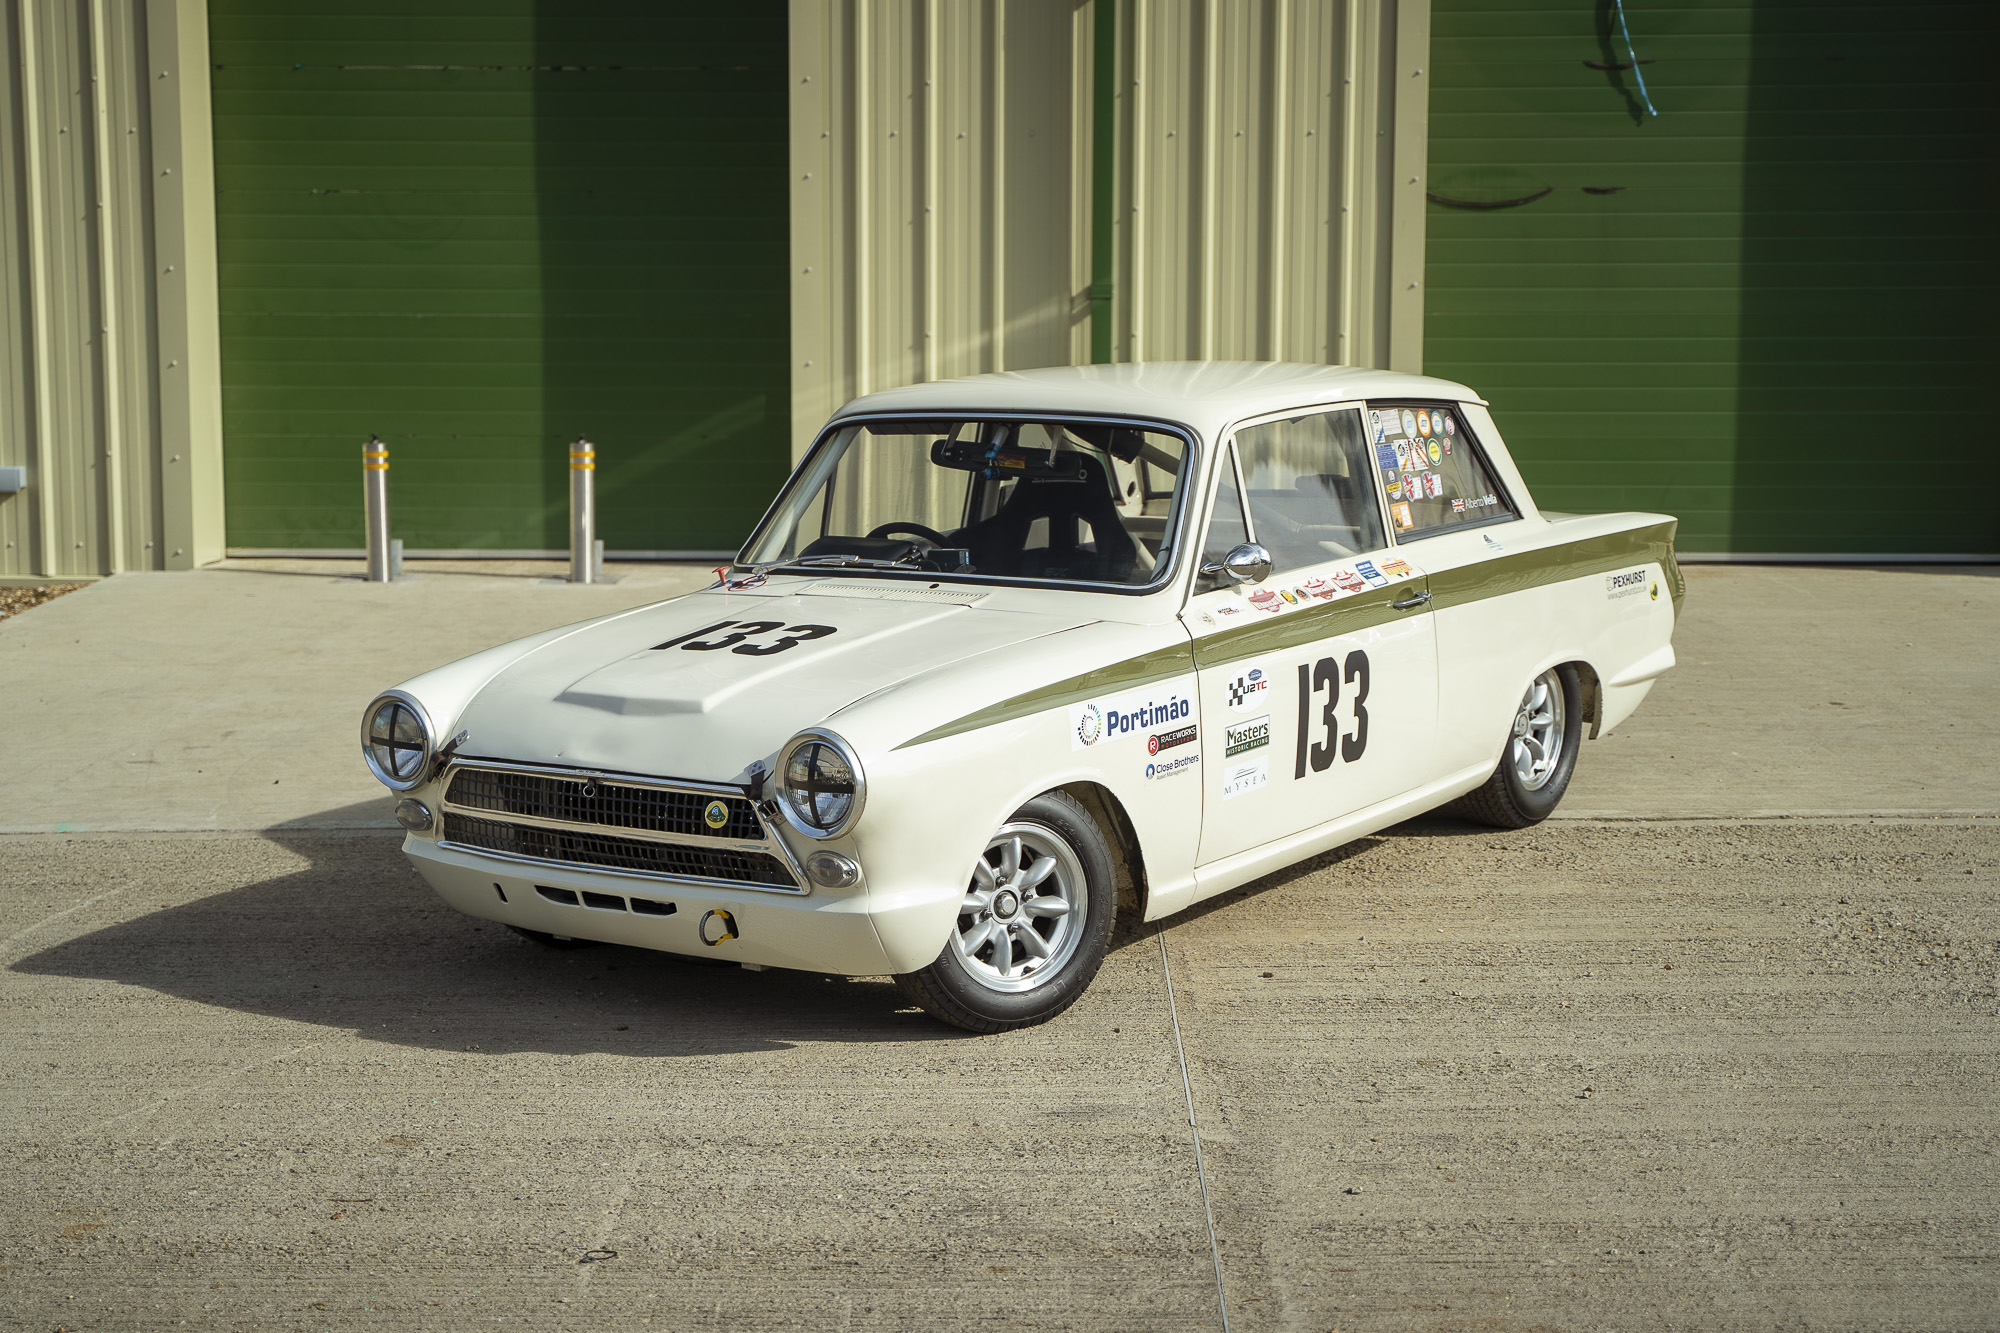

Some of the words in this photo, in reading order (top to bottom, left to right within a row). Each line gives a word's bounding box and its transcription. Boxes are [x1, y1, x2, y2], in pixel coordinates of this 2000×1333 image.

[1613, 570, 1646, 588] PEXHURST
[648, 620, 838, 656] 133
[1243, 680, 1267, 694] U2TC
[1107, 695, 1189, 737] Portimão
[1294, 649, 1370, 780] 133
[1160, 726, 1196, 743] RACEWORKS
[1227, 723, 1268, 746] Masters
[1226, 743, 1249, 756] HISTORIC
[1250, 736, 1269, 749] RACING
[1156, 763, 1173, 774] Close
[1174, 754, 1199, 768] Brothers
